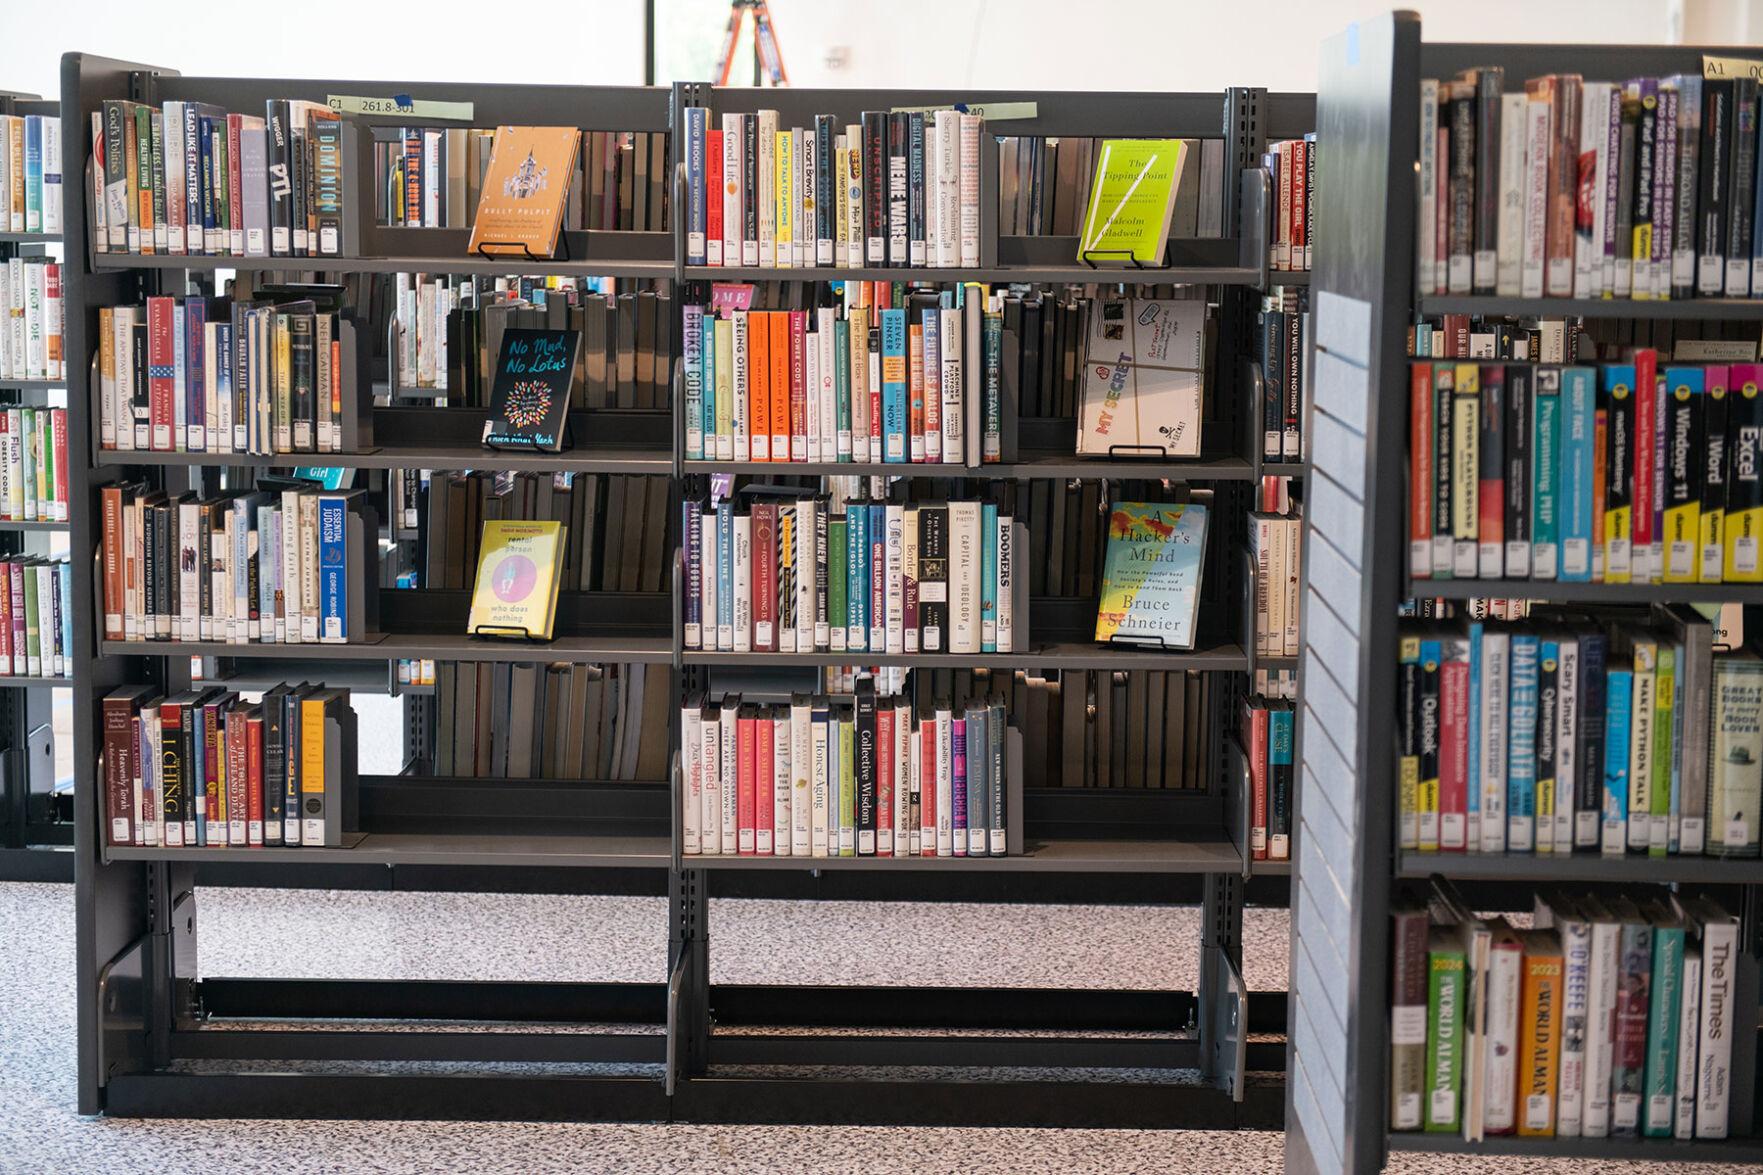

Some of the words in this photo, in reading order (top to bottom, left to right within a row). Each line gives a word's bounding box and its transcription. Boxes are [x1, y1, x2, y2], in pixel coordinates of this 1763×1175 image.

[1707, 62, 1724, 75] A1
[186, 108, 196, 132] LEAD
[329, 99, 342, 109] C1
[1611, 92, 1619, 124] VIDEO
[109, 106, 120, 136] God's
[272, 115, 284, 147] WIGGER
[912, 117, 921, 146] DIGITAL
[1642, 117, 1653, 142] iPad
[111, 139, 121, 174] Politics
[140, 138, 148, 165] HEALTHY
[187, 132, 196, 152] LIKE
[188, 153, 197, 163] IT
[805, 140, 813, 167] Smart
[1296, 143, 1304, 161] YOU
[1608, 127, 1618, 176] CHATTING
[1641, 145, 1651, 167] and
[1682, 144, 1693, 171] THE
[141, 166, 149, 187] LIVING
[269, 163, 291, 201] PTL
[319, 135, 337, 212] DOMINION
[890, 156, 906, 198] MEME
[913, 148, 922, 183] MADNESS
[1295, 164, 1303, 186] PLAY
[188, 163, 198, 204] MATTERS
[804, 169, 814, 199] Brevity
[1295, 188, 1303, 205] THE
[1608, 180, 1616, 198] FOR
[1640, 170, 1651, 195] iPad
[1680, 174, 1692, 208] ROAD
[1294, 207, 1302, 227] GIRL
[1605, 201, 1615, 243] SENIORS
[1639, 197, 1649, 216] Pro
[1639, 228, 1650, 259] dumm
[1678, 210, 1690, 254] AHEAD
[320, 321, 328, 347] NEIL
[686, 312, 700, 365] BROKEN
[736, 317, 744, 353] SEEING
[885, 317, 893, 351] PINKER
[894, 316, 902, 350] STEVEN
[926, 316, 936, 334] THE
[509, 341, 528, 354] No
[534, 335, 566, 356] Mud,
[926, 336, 937, 372] FUTURE
[320, 352, 328, 399] GAIMAN
[506, 358, 526, 373] No
[528, 355, 567, 373] Lotus
[736, 356, 745, 396] OTHERS
[927, 375, 937, 384] IS
[988, 351, 998, 376] THE
[687, 371, 700, 405] CODE
[1095, 410, 1113, 436] MY
[1104, 351, 1133, 409] SECRET
[1290, 378, 1298, 415] NOTHING
[927, 388, 938, 424] ANALOG
[1656, 383, 1667, 433] WINDOWS
[1615, 411, 1625, 445] macOS
[1655, 437, 1665, 446] 11
[1674, 407, 1691, 479] Windows
[10, 436, 19, 464] Flush
[1538, 401, 1555, 492] Programming
[1655, 450, 1664, 468] FOR
[1707, 440, 1723, 484] Word
[1738, 426, 1758, 481] Excel
[310, 467, 329, 478] Girl
[1612, 447, 1625, 495] Monterey
[1654, 471, 1664, 512] SENIORS
[1674, 483, 1689, 499] 11
[323, 507, 333, 543] JUDAISM
[333, 508, 342, 543] ESSENTIAL
[816, 511, 826, 535] THEY
[1152, 510, 1163, 525] A
[1540, 495, 1553, 524] PHP
[690, 508, 700, 546] TALKING
[1120, 528, 1190, 545] Hacker's
[1614, 512, 1624, 541] dumm
[1675, 513, 1685, 542] dumm
[1710, 513, 1719, 545] dumm
[1743, 513, 1752, 540] dumm
[690, 549, 700, 561] TO
[817, 536, 827, 564] KNEW
[906, 544, 916, 577] Border
[960, 535, 970, 569] CAPITAL
[1000, 524, 1010, 587] BOOMERS
[1129, 547, 1175, 563] Mind
[690, 563, 700, 598] ROBOTS
[874, 560, 882, 589] BILLION
[510, 605, 528, 613] does
[874, 591, 882, 629] AMERICAN
[906, 588, 916, 610] Rule
[961, 583, 969, 623] IDEOLOGY
[1122, 595, 1170, 611] Bruce
[492, 615, 523, 623] nothing
[1107, 613, 1181, 631] Schneier
[1512, 644, 1537, 688] DATA
[1561, 654, 1575, 692] Scary
[1444, 666, 1455, 726] Applications
[1639, 678, 1649, 714] MAKE
[1721, 686, 1762, 694] GREAT
[1540, 687, 1555, 761] Cybersecurity
[1561, 696, 1574, 737] Smart
[815, 739, 825, 776] Honest
[861, 730, 872, 780] Collective
[1510, 705, 1535, 778] GOLIATH
[1637, 719, 1647, 769] PYTHON
[118, 749, 128, 786] Heavenly
[704, 727, 717, 790] untangled
[162, 751, 178, 813] CHING
[813, 779, 825, 809] Aging
[1636, 775, 1646, 806] TALK
[120, 788, 130, 810] Torah
[861, 782, 872, 824] Wisdom
[1541, 783, 1552, 815] dumm
[1711, 942, 1730, 979] The
[1568, 949, 1588, 1010] O'KEEFE
[1438, 981, 1455, 1038] WORLD
[1534, 990, 1552, 1043] WORLD
[1708, 980, 1729, 1041] Times
[1436, 1041, 1451, 1093] ALMAN
[1532, 1048, 1549, 1096] ALMAN
[1715, 1066, 1726, 1096] Adam
